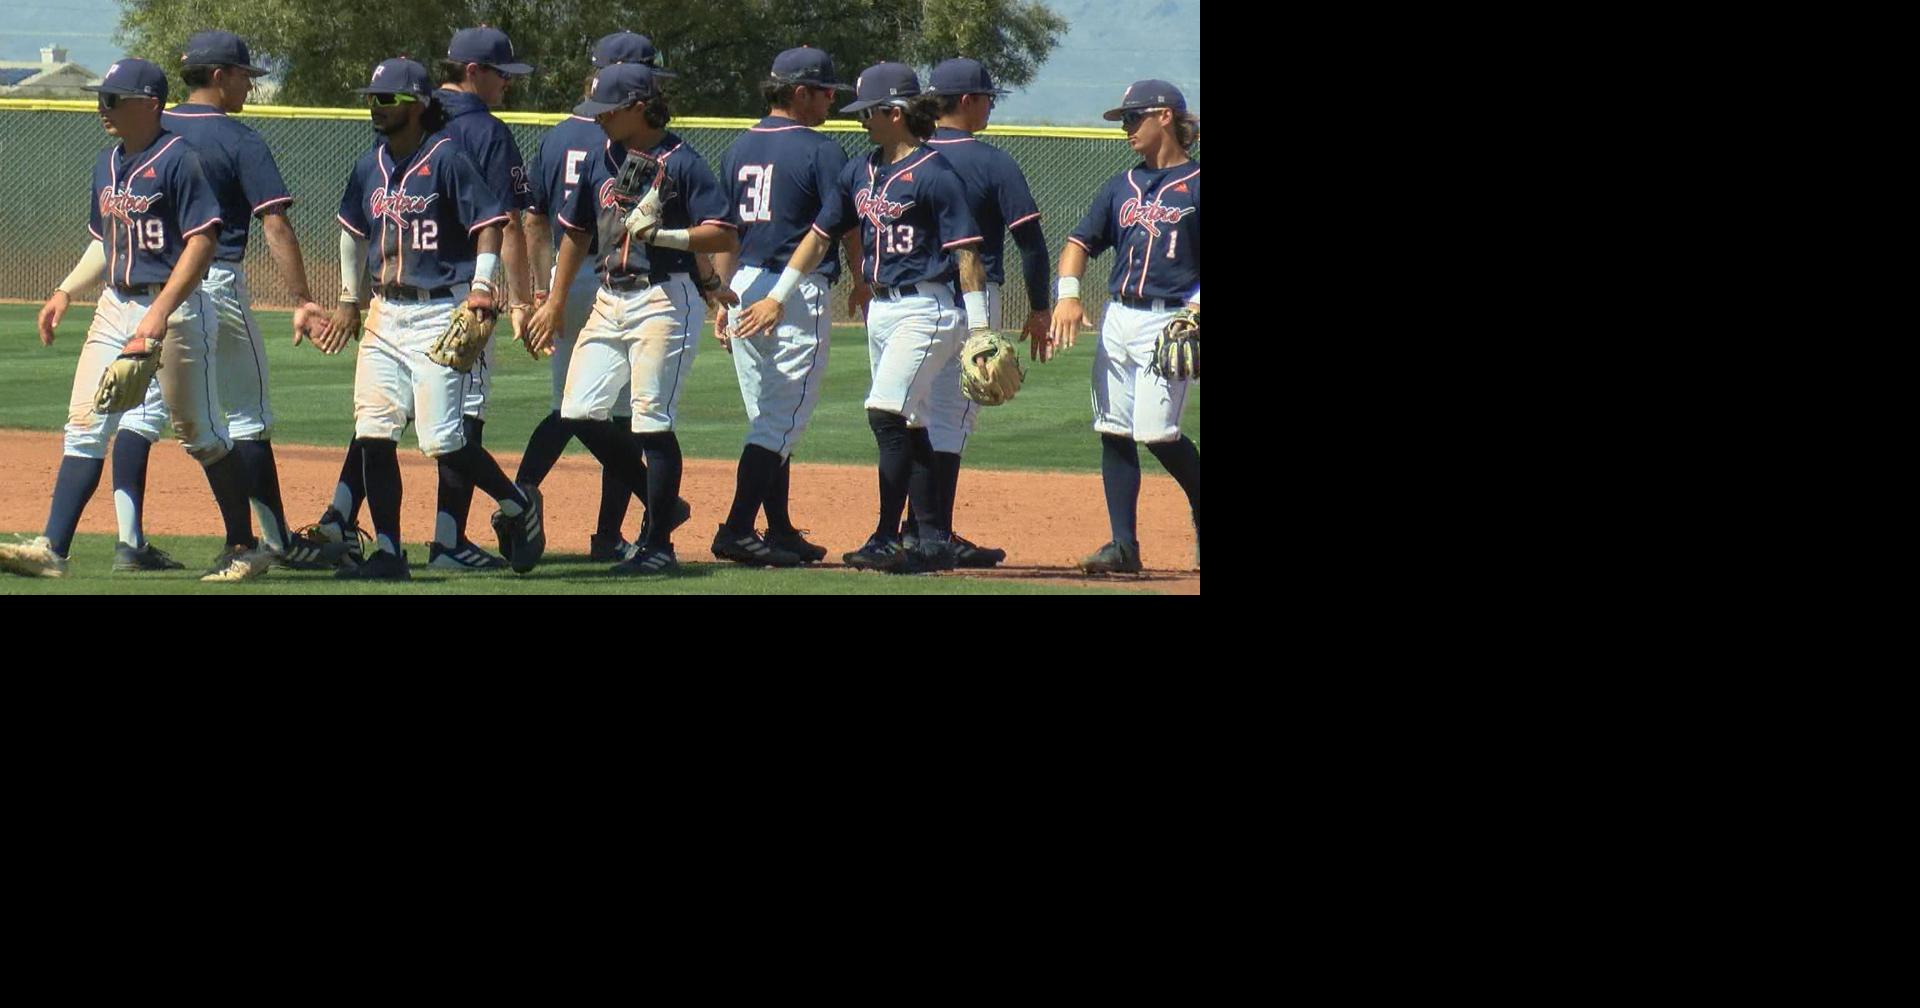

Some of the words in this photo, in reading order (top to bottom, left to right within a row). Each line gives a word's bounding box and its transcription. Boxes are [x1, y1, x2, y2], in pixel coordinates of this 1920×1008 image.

[370, 187, 439, 229] Aztecs
[737, 163, 774, 222] 31
[1119, 197, 1196, 237] Aztecs
[136, 218, 165, 250] 19
[410, 218, 439, 250] 12
[886, 223, 915, 254] 13
[1165, 229, 1179, 259] 1
